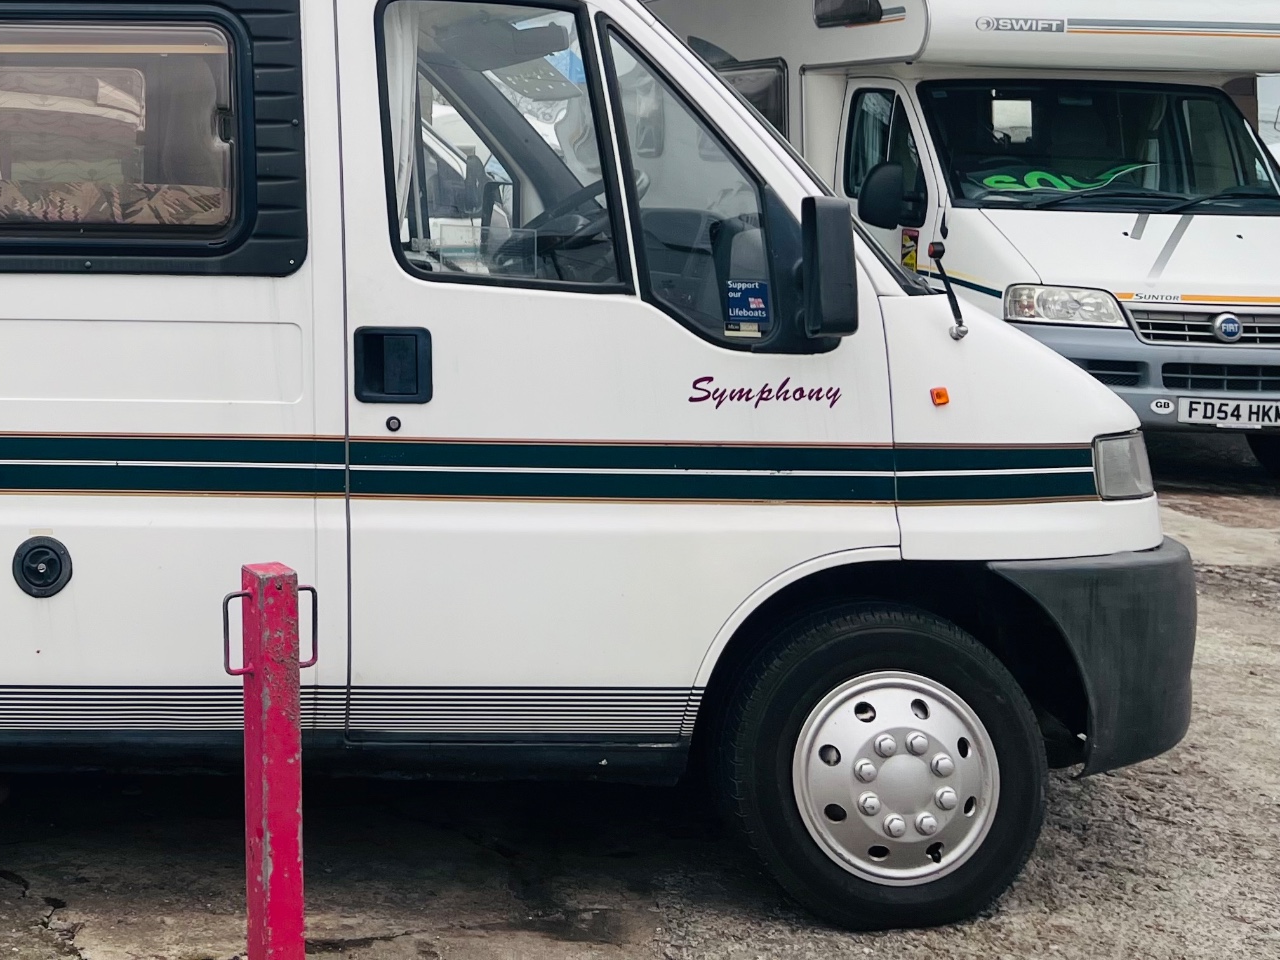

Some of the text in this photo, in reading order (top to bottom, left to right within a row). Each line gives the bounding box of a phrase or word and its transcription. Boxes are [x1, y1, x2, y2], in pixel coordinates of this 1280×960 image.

[998, 19, 1061, 31] SWIFT
[727, 280, 760, 290] Support
[729, 308, 767, 317] Lifeboats
[1221, 323, 1240, 332] FIAT
[688, 376, 842, 409] Symphony
[1155, 401, 1170, 409] GB
[1188, 401, 1242, 421] FD54
